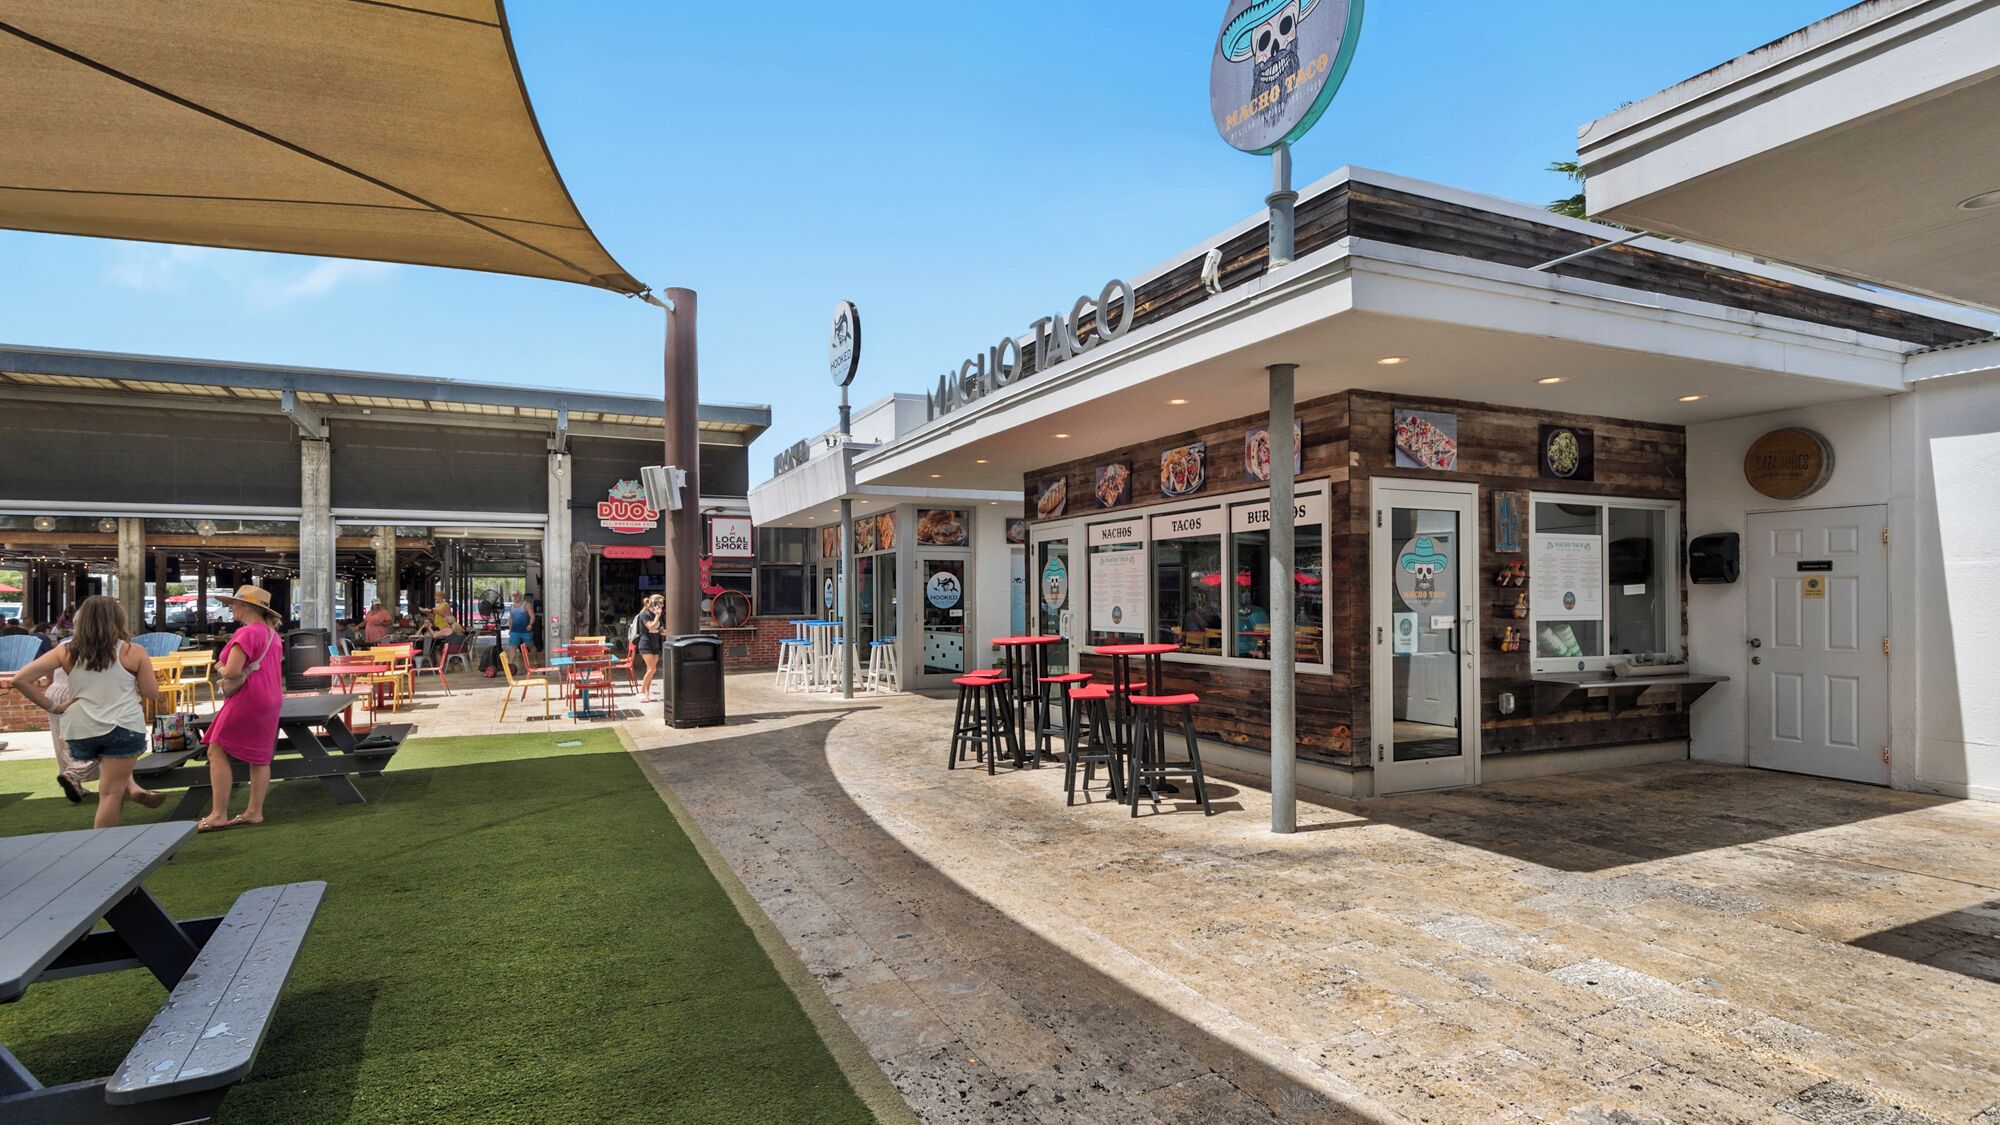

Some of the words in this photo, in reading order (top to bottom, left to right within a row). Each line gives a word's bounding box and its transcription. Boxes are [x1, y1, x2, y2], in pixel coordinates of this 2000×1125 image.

[1225, 84, 1280, 132] MACHO
[1285, 53, 1328, 93] TACO
[927, 336, 1022, 422] MACHO
[1030, 279, 1135, 372] TACO
[830, 349, 852, 371] HOOKED
[598, 502, 659, 520] DUOS
[1247, 504, 1307, 524] BUROS
[1101, 526, 1132, 540] NACHOS
[1171, 518, 1202, 532] TACOS
[715, 535, 749, 544] LOCAL
[715, 542, 749, 550] SMOKE
